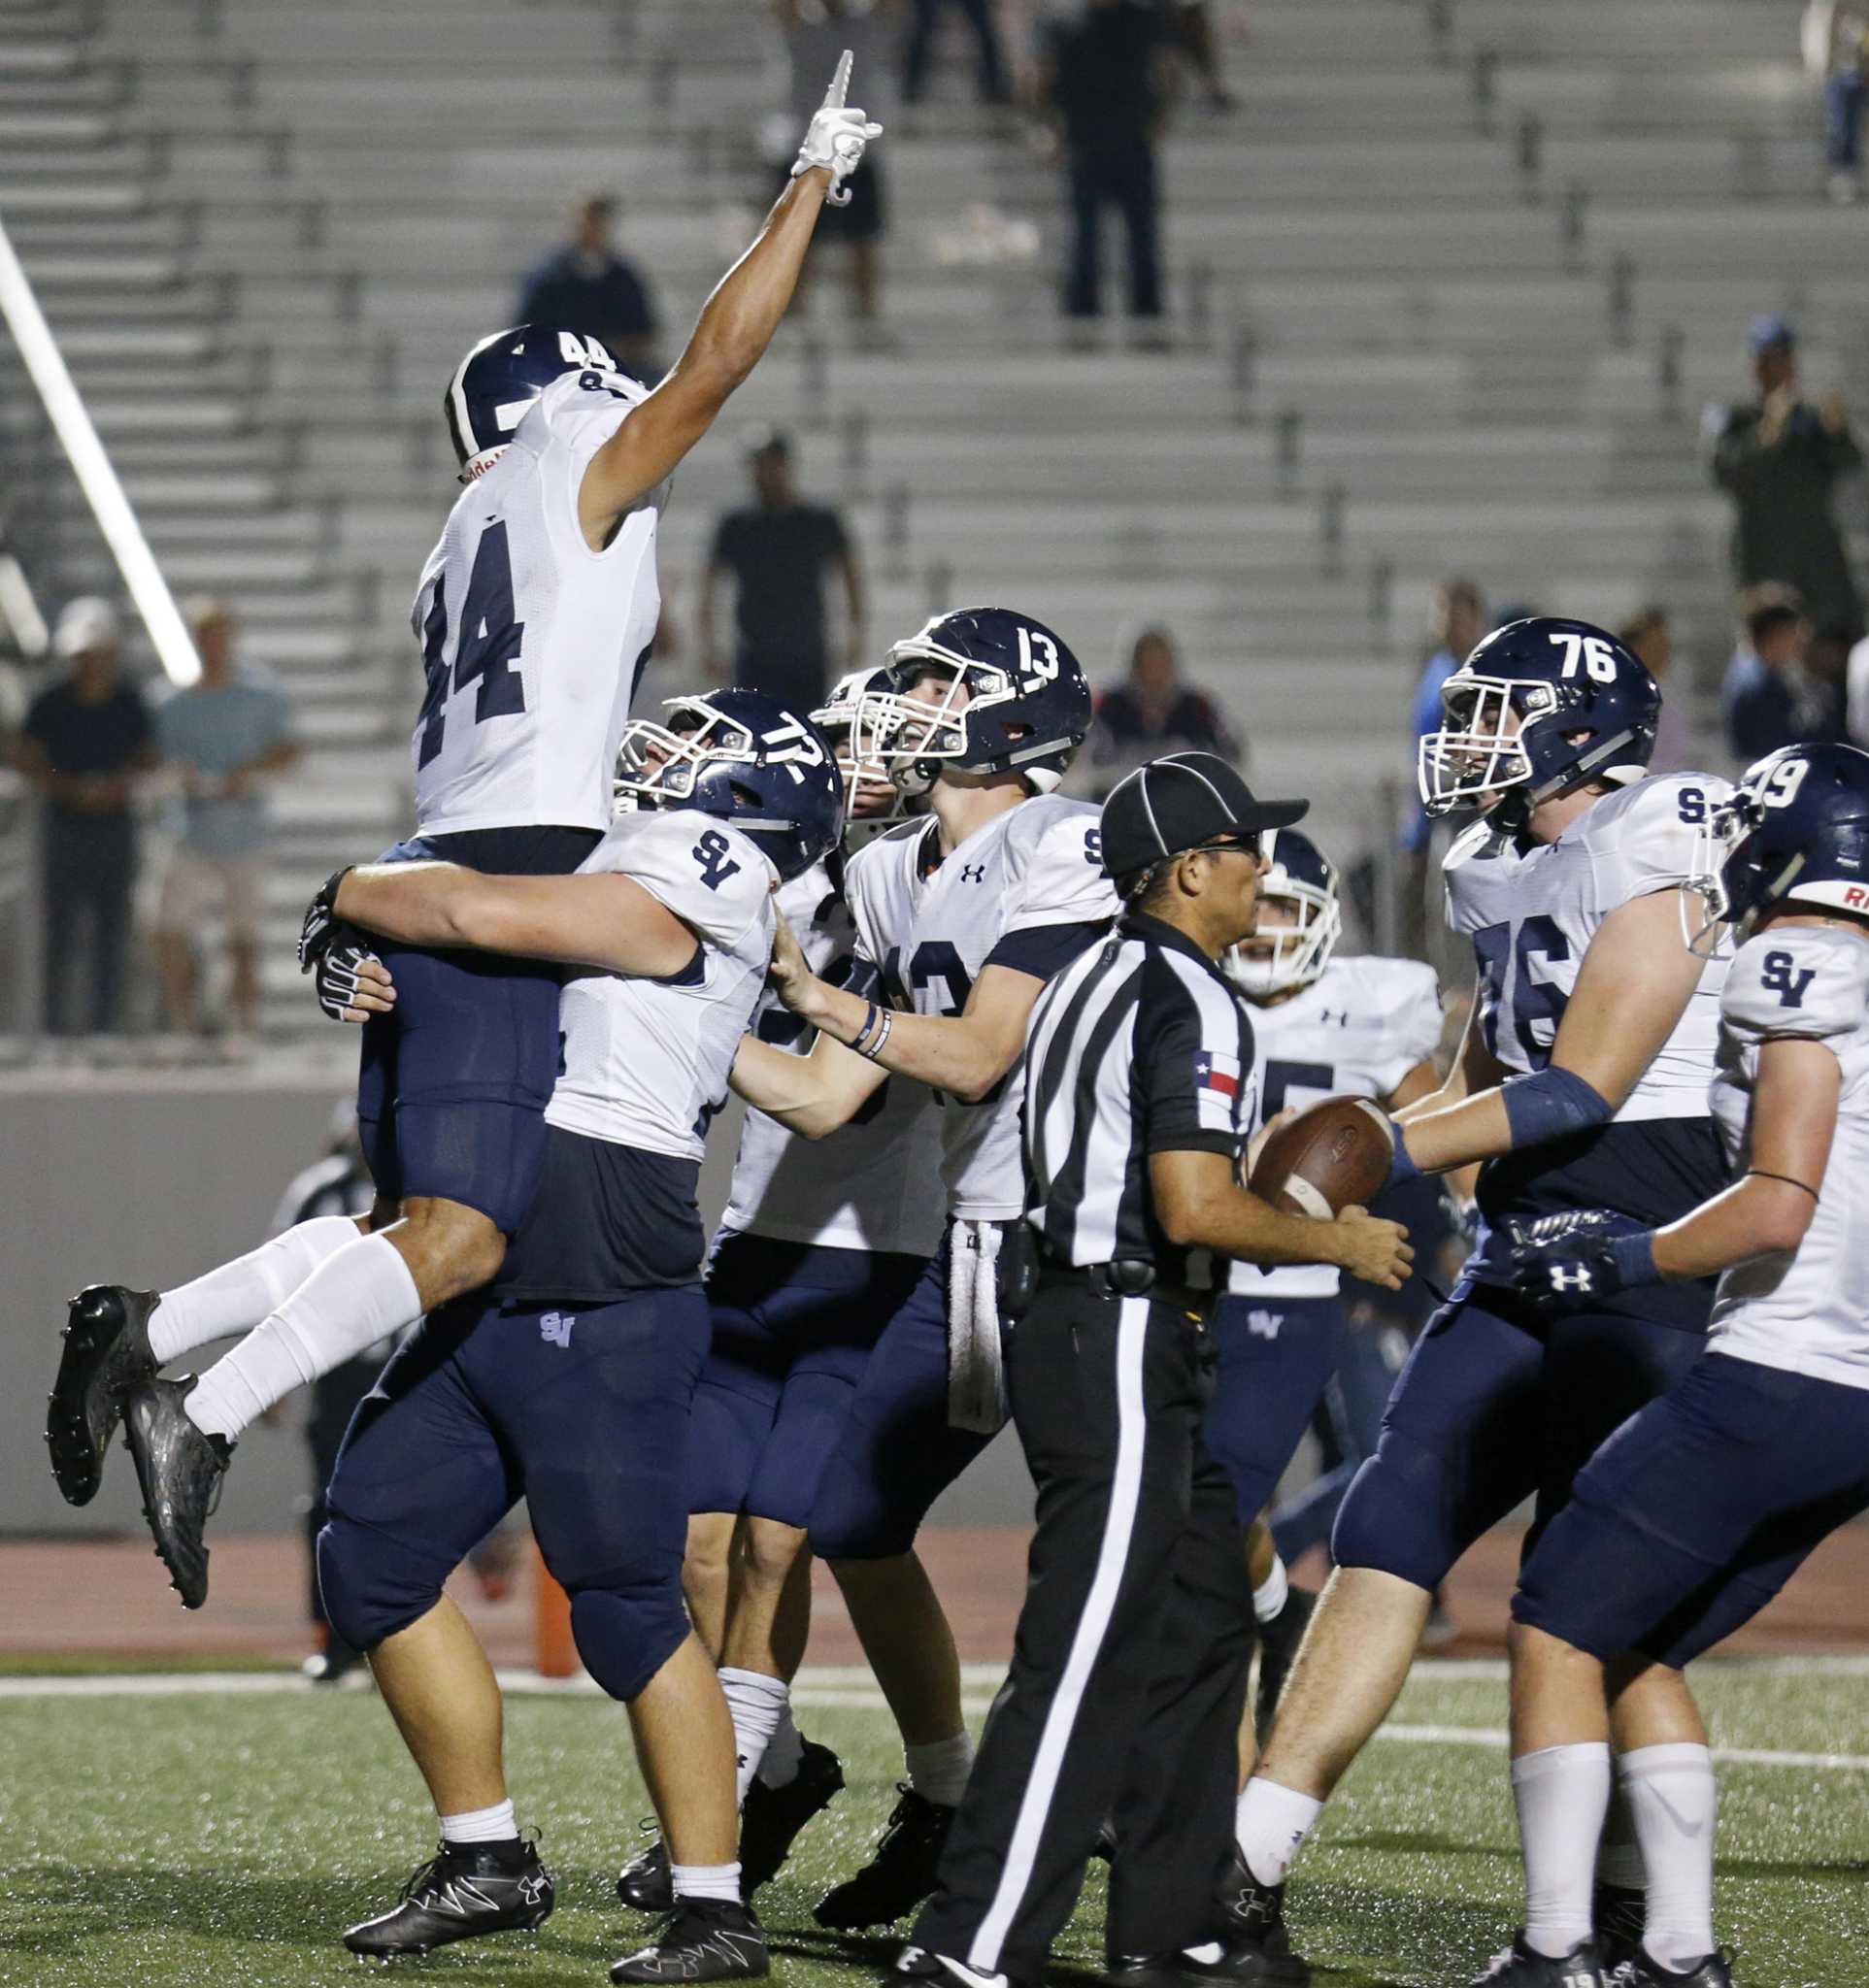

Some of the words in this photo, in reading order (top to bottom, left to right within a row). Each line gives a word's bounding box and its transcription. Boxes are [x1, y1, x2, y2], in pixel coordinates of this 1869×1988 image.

[557, 331, 617, 373] 44
[1017, 627, 1059, 680] 13
[1548, 633, 1618, 683] 76
[760, 711, 824, 785] 72
[1742, 758, 1811, 809] 79
[692, 829, 741, 891] SV
[1473, 914, 1571, 1072] 76
[1760, 950, 1817, 1009] SV
[540, 1311, 576, 1347] SV
